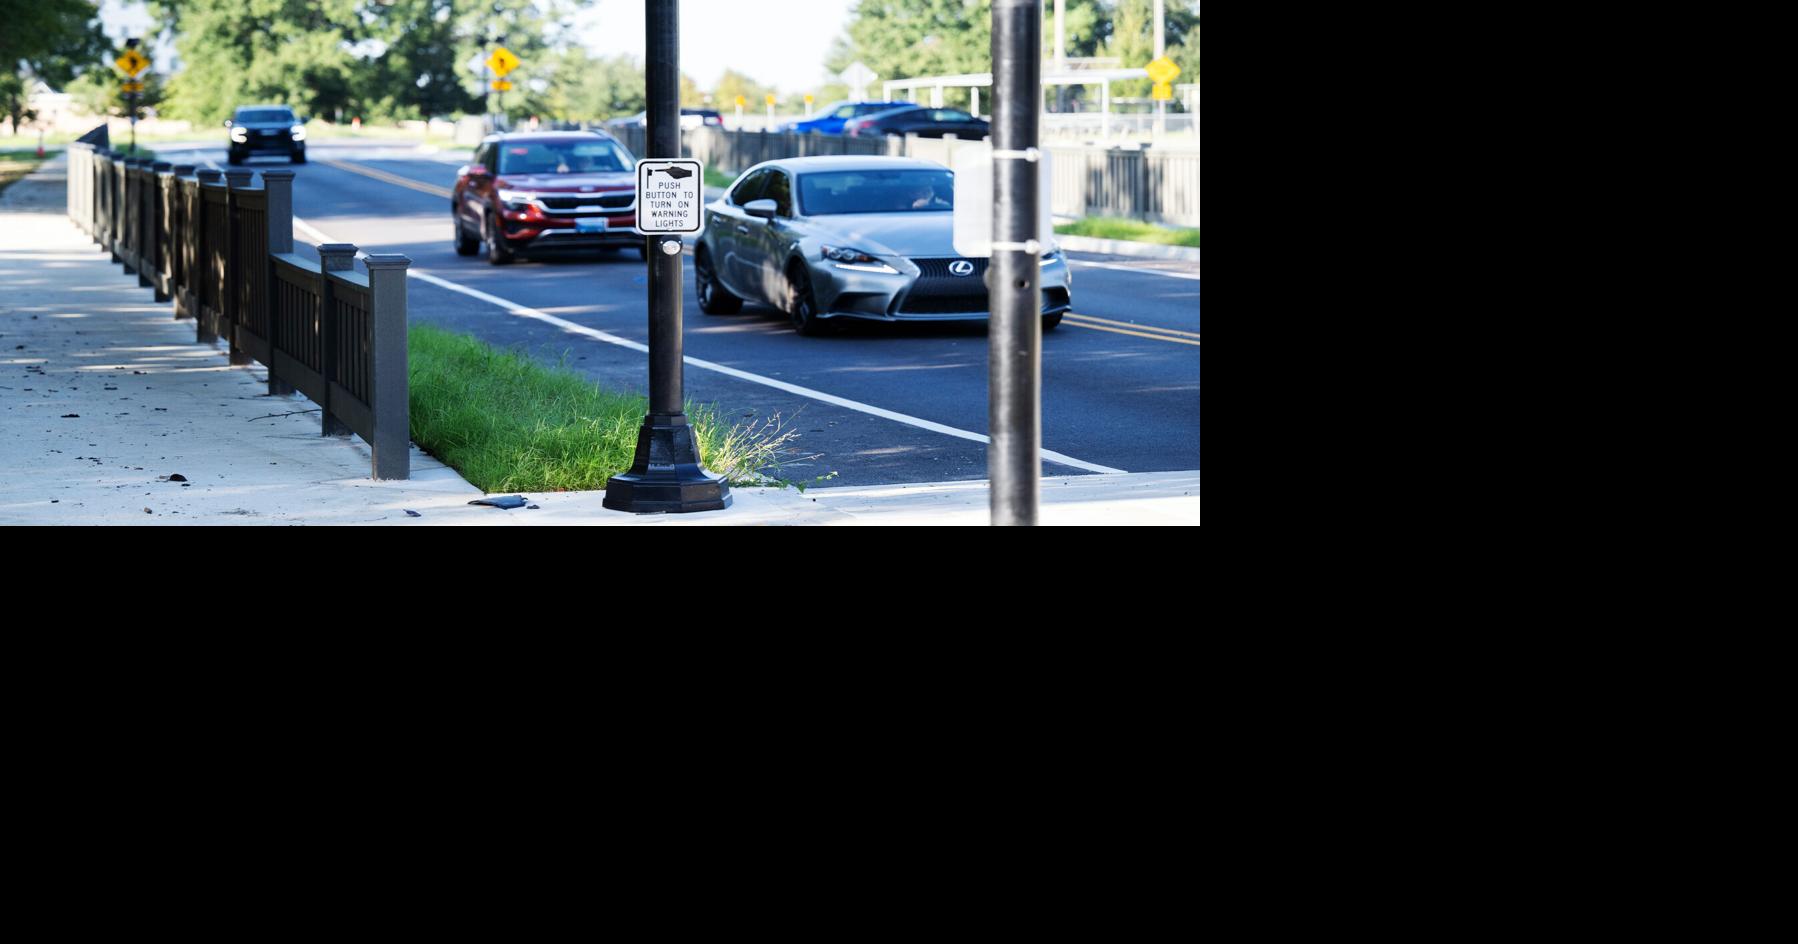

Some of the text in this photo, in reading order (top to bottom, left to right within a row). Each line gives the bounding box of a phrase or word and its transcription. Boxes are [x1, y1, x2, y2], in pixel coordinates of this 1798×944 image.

[658, 182, 681, 190] PUSH
[645, 191, 694, 199] BUTTON TO
[651, 210, 689, 218] WARNING
[655, 219, 684, 228] LIGHTS
